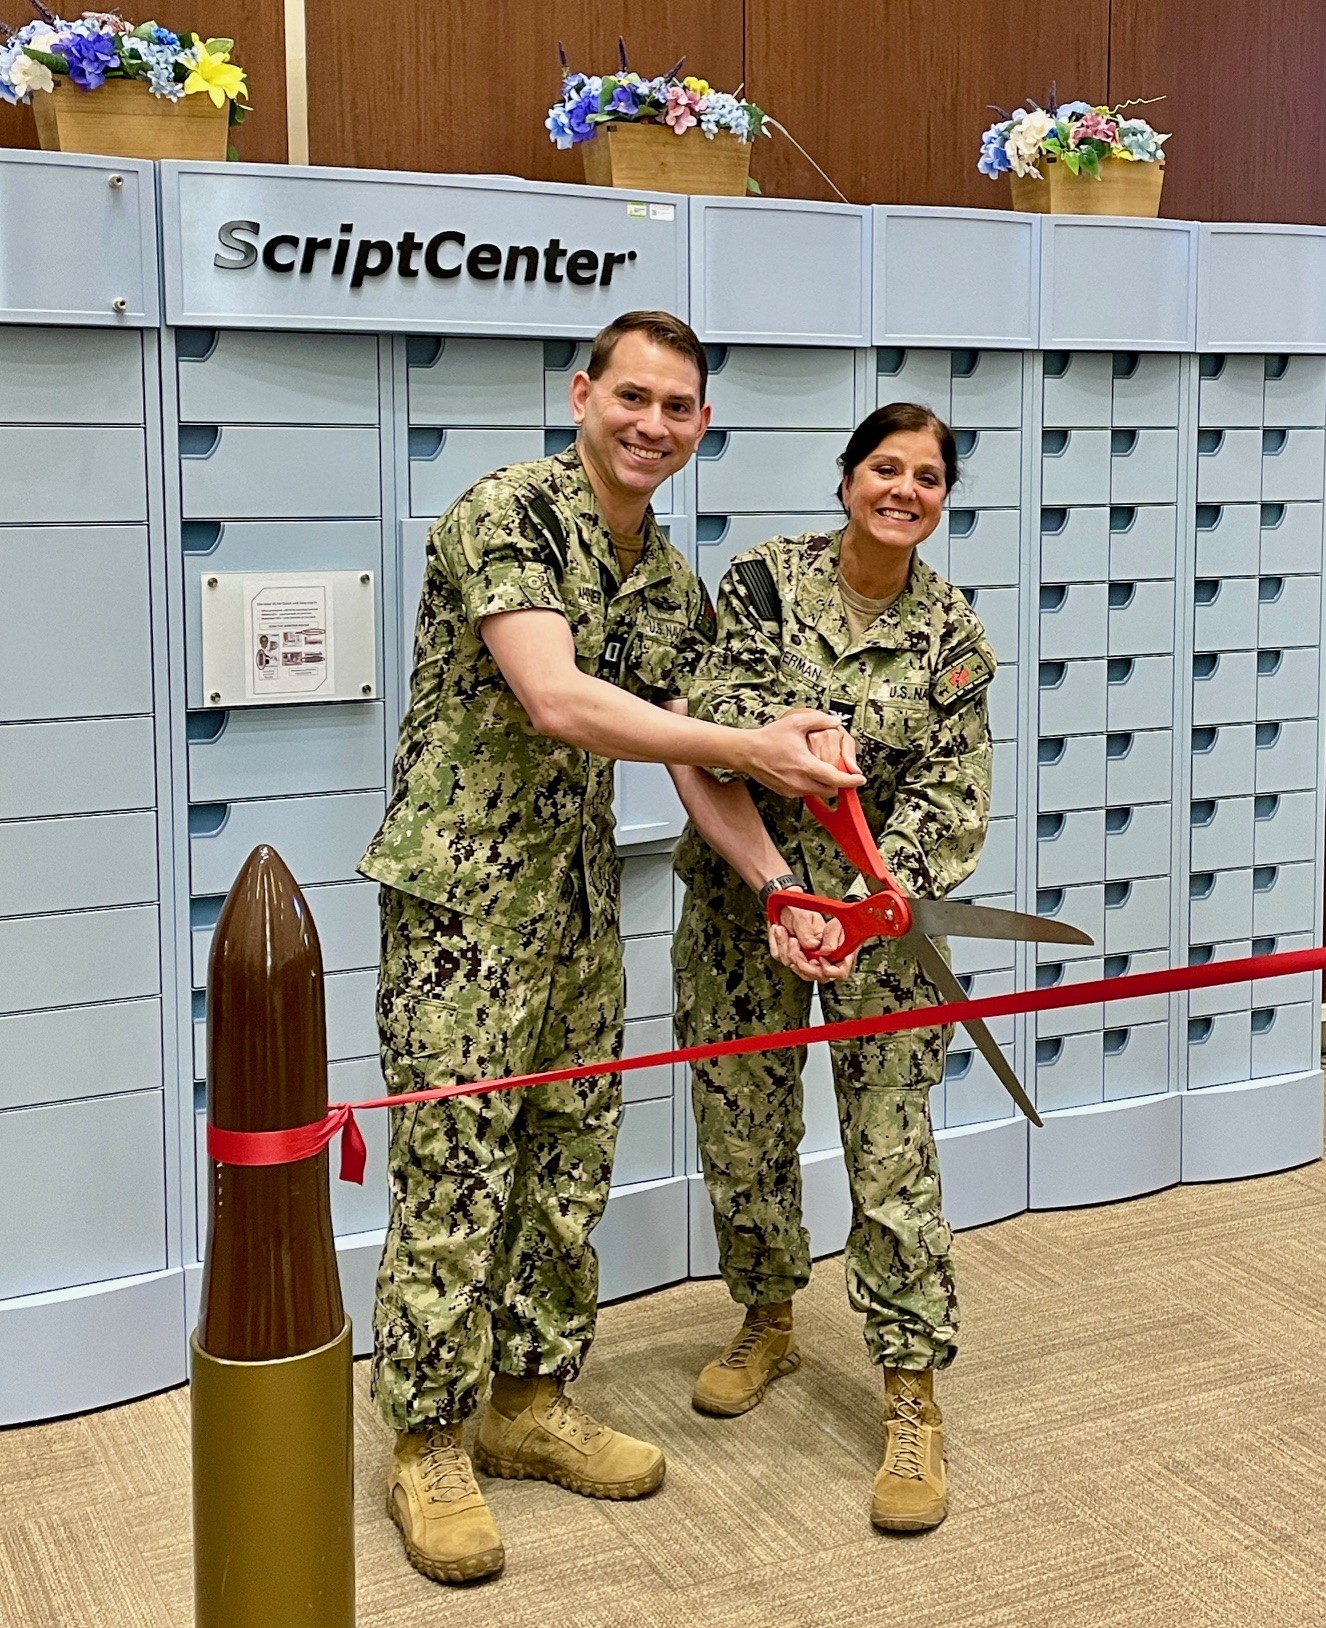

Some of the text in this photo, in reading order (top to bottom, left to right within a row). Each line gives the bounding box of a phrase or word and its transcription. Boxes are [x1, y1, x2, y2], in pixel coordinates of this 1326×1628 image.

[213, 220, 628, 288] ScriptCenter
[781, 649, 822, 682] ERMAN
[889, 685, 912, 699] U.S.
[913, 687, 929, 701] NA
